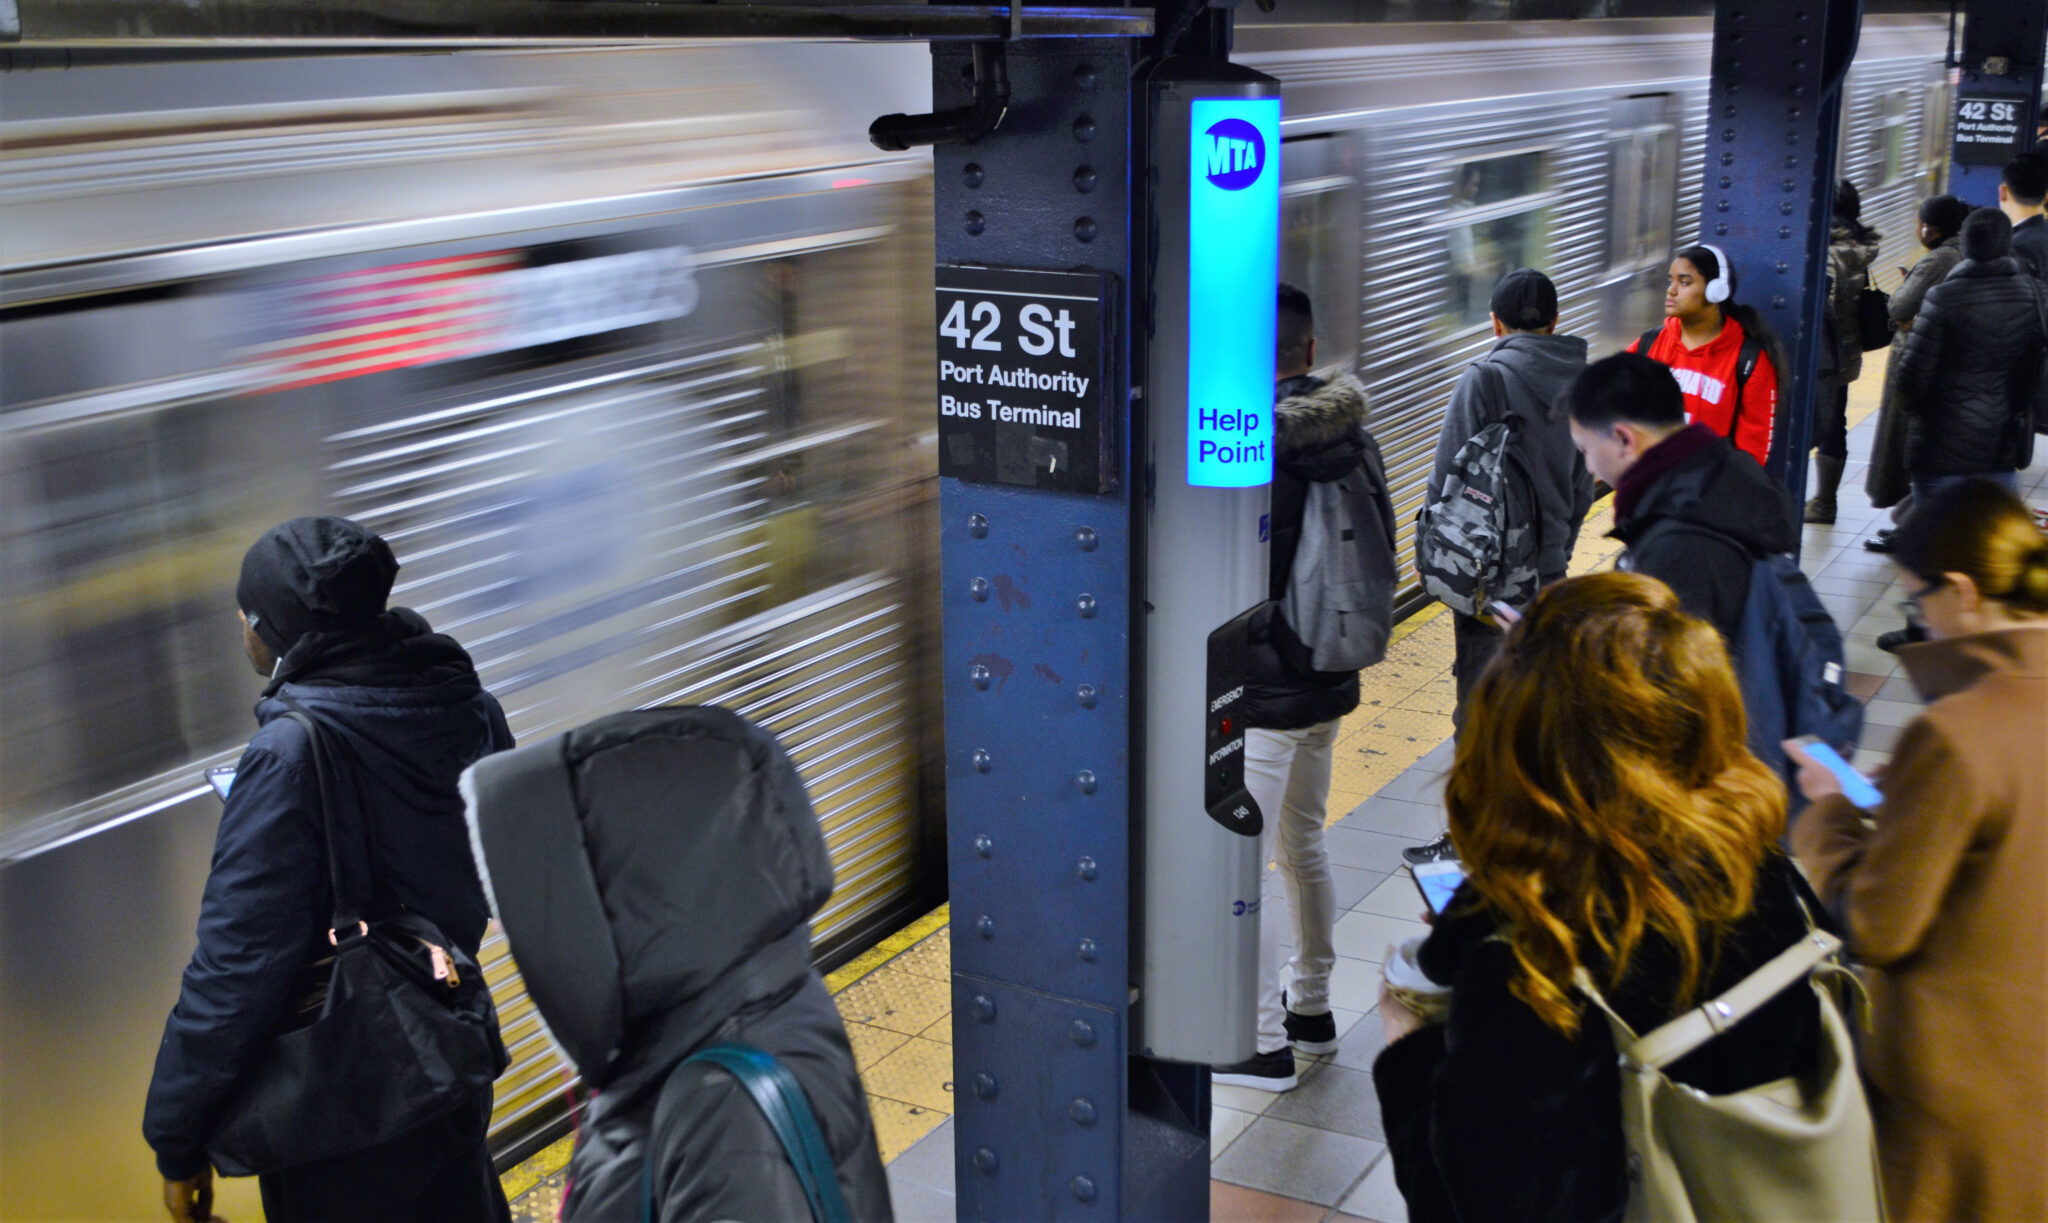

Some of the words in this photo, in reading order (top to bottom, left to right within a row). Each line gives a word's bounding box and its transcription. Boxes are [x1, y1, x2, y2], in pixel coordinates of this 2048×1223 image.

[1959, 102, 1985, 119] 42
[1990, 103, 2015, 121] St
[1956, 134, 1974, 142] Bus
[1975, 134, 2014, 144] Terminal
[1957, 122, 1976, 131] Port
[1977, 123, 2018, 133] Authority
[1206, 133, 1257, 176] MTA
[940, 300, 1002, 352] 42
[1018, 303, 1076, 358] St
[940, 360, 984, 384] Port
[988, 364, 1089, 398] Authority
[1669, 367, 1722, 405] GUARD
[941, 395, 981, 419] Bus
[986, 399, 1081, 429] Terminal
[1199, 407, 1259, 437] Help
[1199, 440, 1265, 464] Point
[1210, 685, 1244, 713] EMERGENCY
[1209, 736, 1244, 766] INFORMATION
